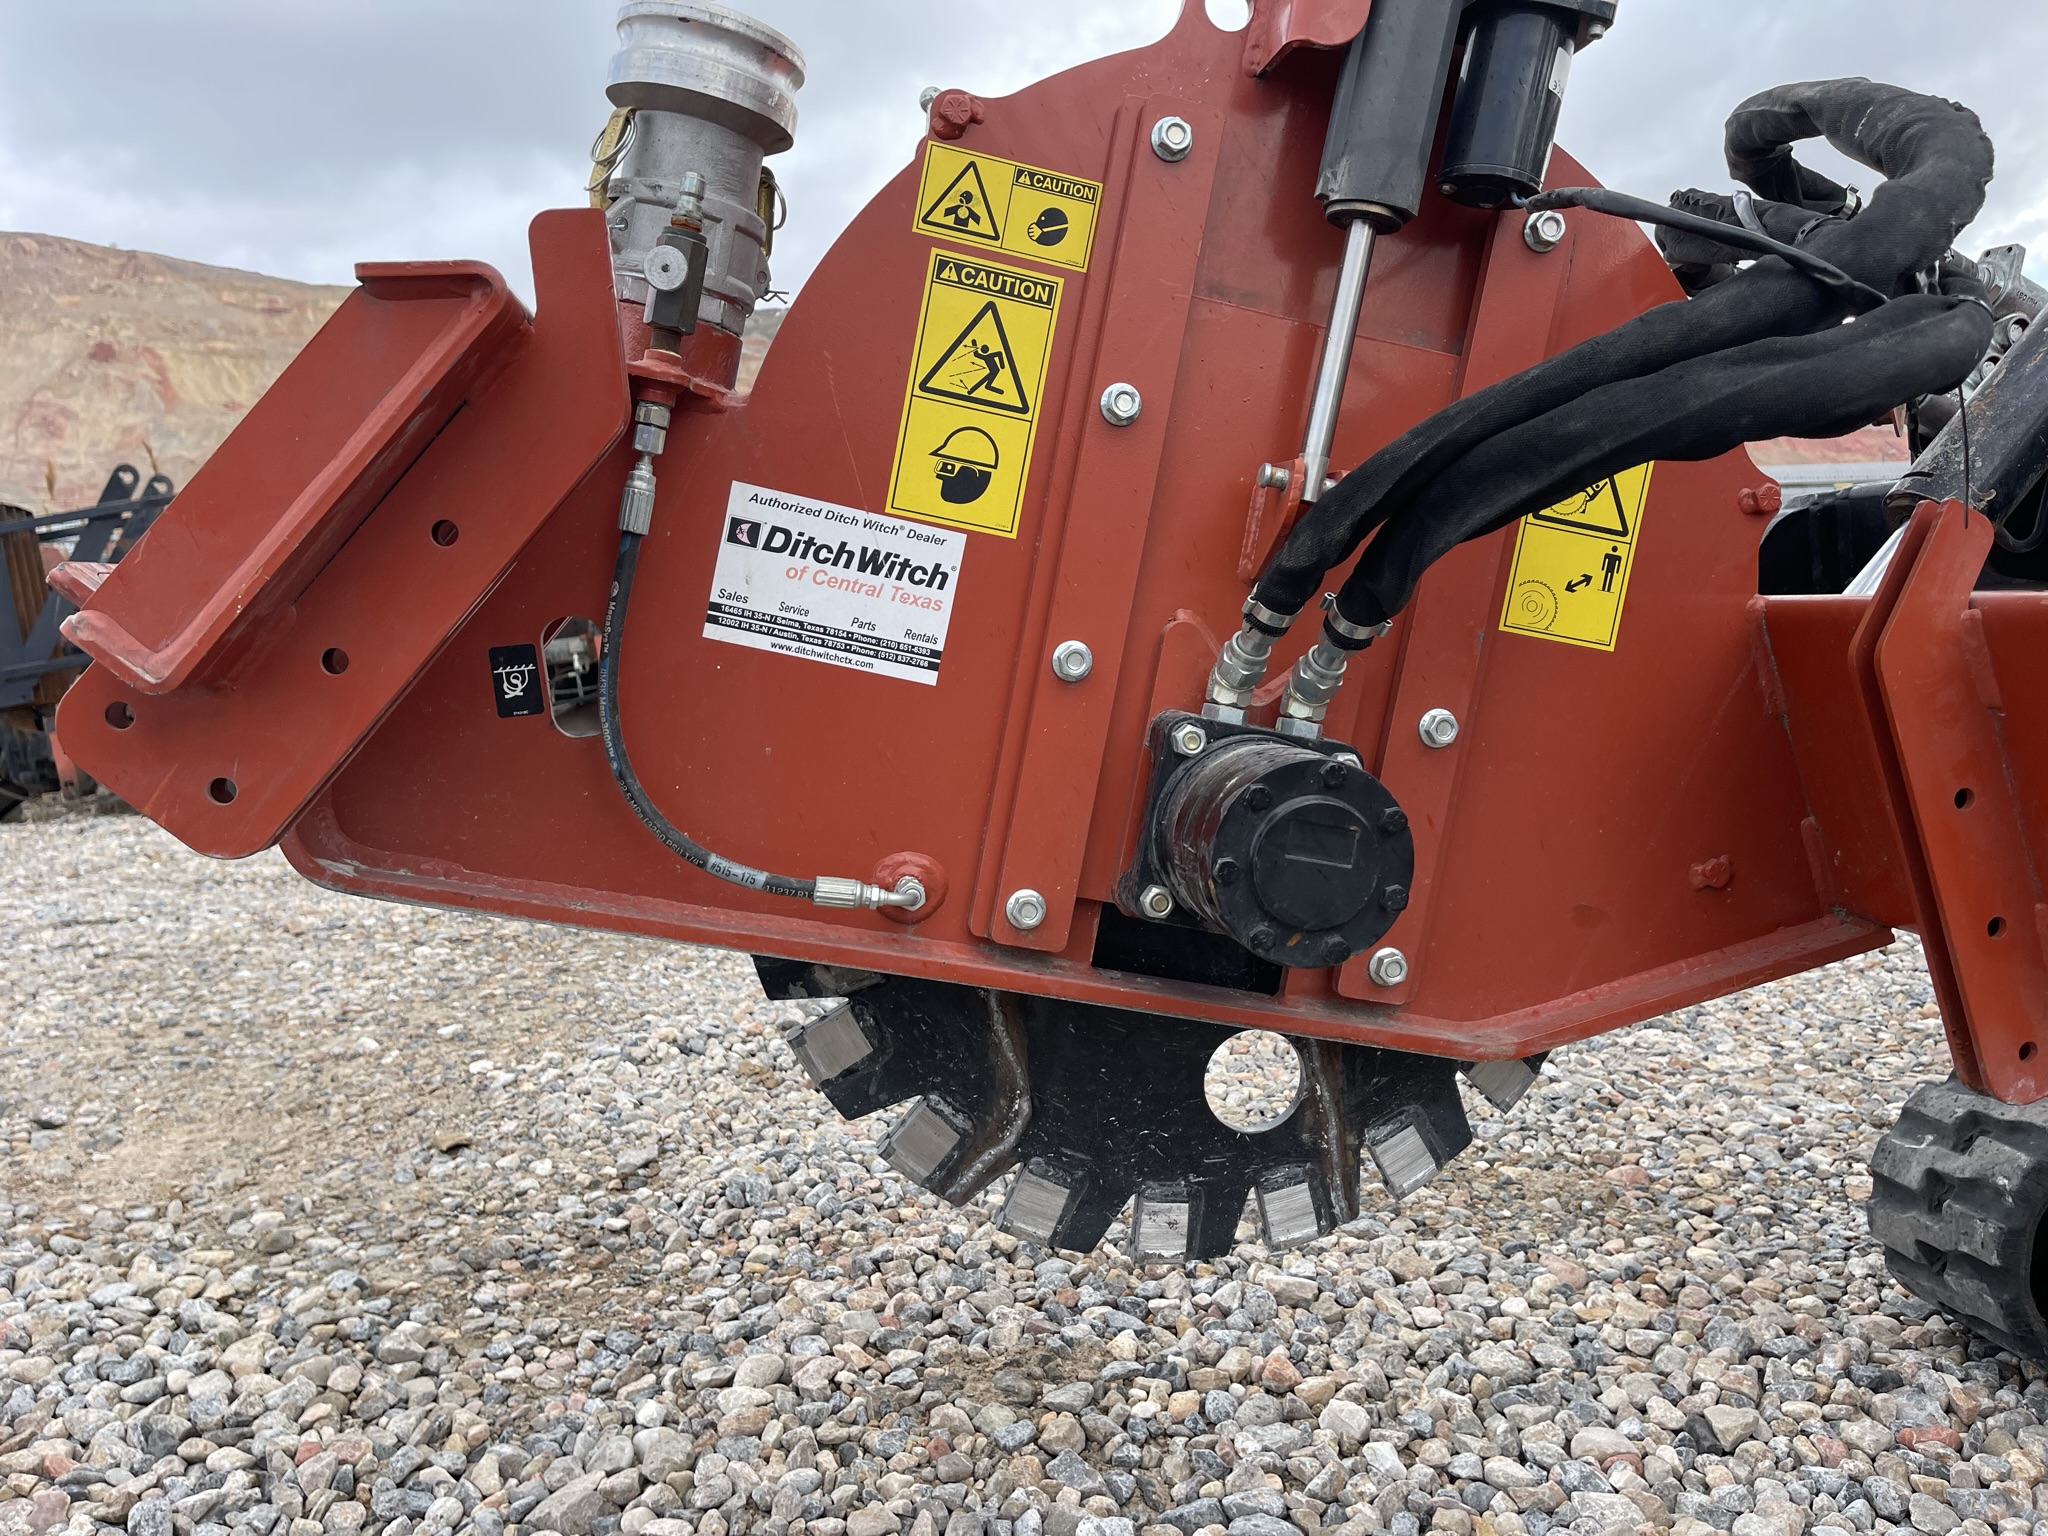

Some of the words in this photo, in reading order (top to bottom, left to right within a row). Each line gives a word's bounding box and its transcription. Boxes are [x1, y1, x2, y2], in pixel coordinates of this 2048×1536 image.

[1033, 174, 1094, 200] CAUTION
[961, 267, 1050, 302] CAUTION
[748, 492, 822, 519] Authorized
[824, 509, 860, 528] Ditch
[906, 528, 947, 547] Dealer
[785, 561, 810, 582] of
[811, 567, 885, 600] Central
[889, 585, 944, 613] Texas
[717, 588, 750, 605] Sales
[778, 600, 810, 618] Service
[851, 617, 877, 633] Parts
[904, 628, 939, 646] Rentals
[743, 610, 752, 618] IH
[753, 612, 771, 622] 35-N
[802, 622, 824, 633] Texas
[825, 627, 847, 638] 78154
[853, 633, 879, 645] Phone:
[879, 639, 898, 650] (210)
[717, 617, 740, 628] 12002
[750, 624, 768, 634] 35-N
[801, 634, 822, 645] Texas
[851, 645, 877, 657] Phone:
[877, 651, 896, 661] (512)
[770, 637, 874, 672] www.ditchwitchctx.com
